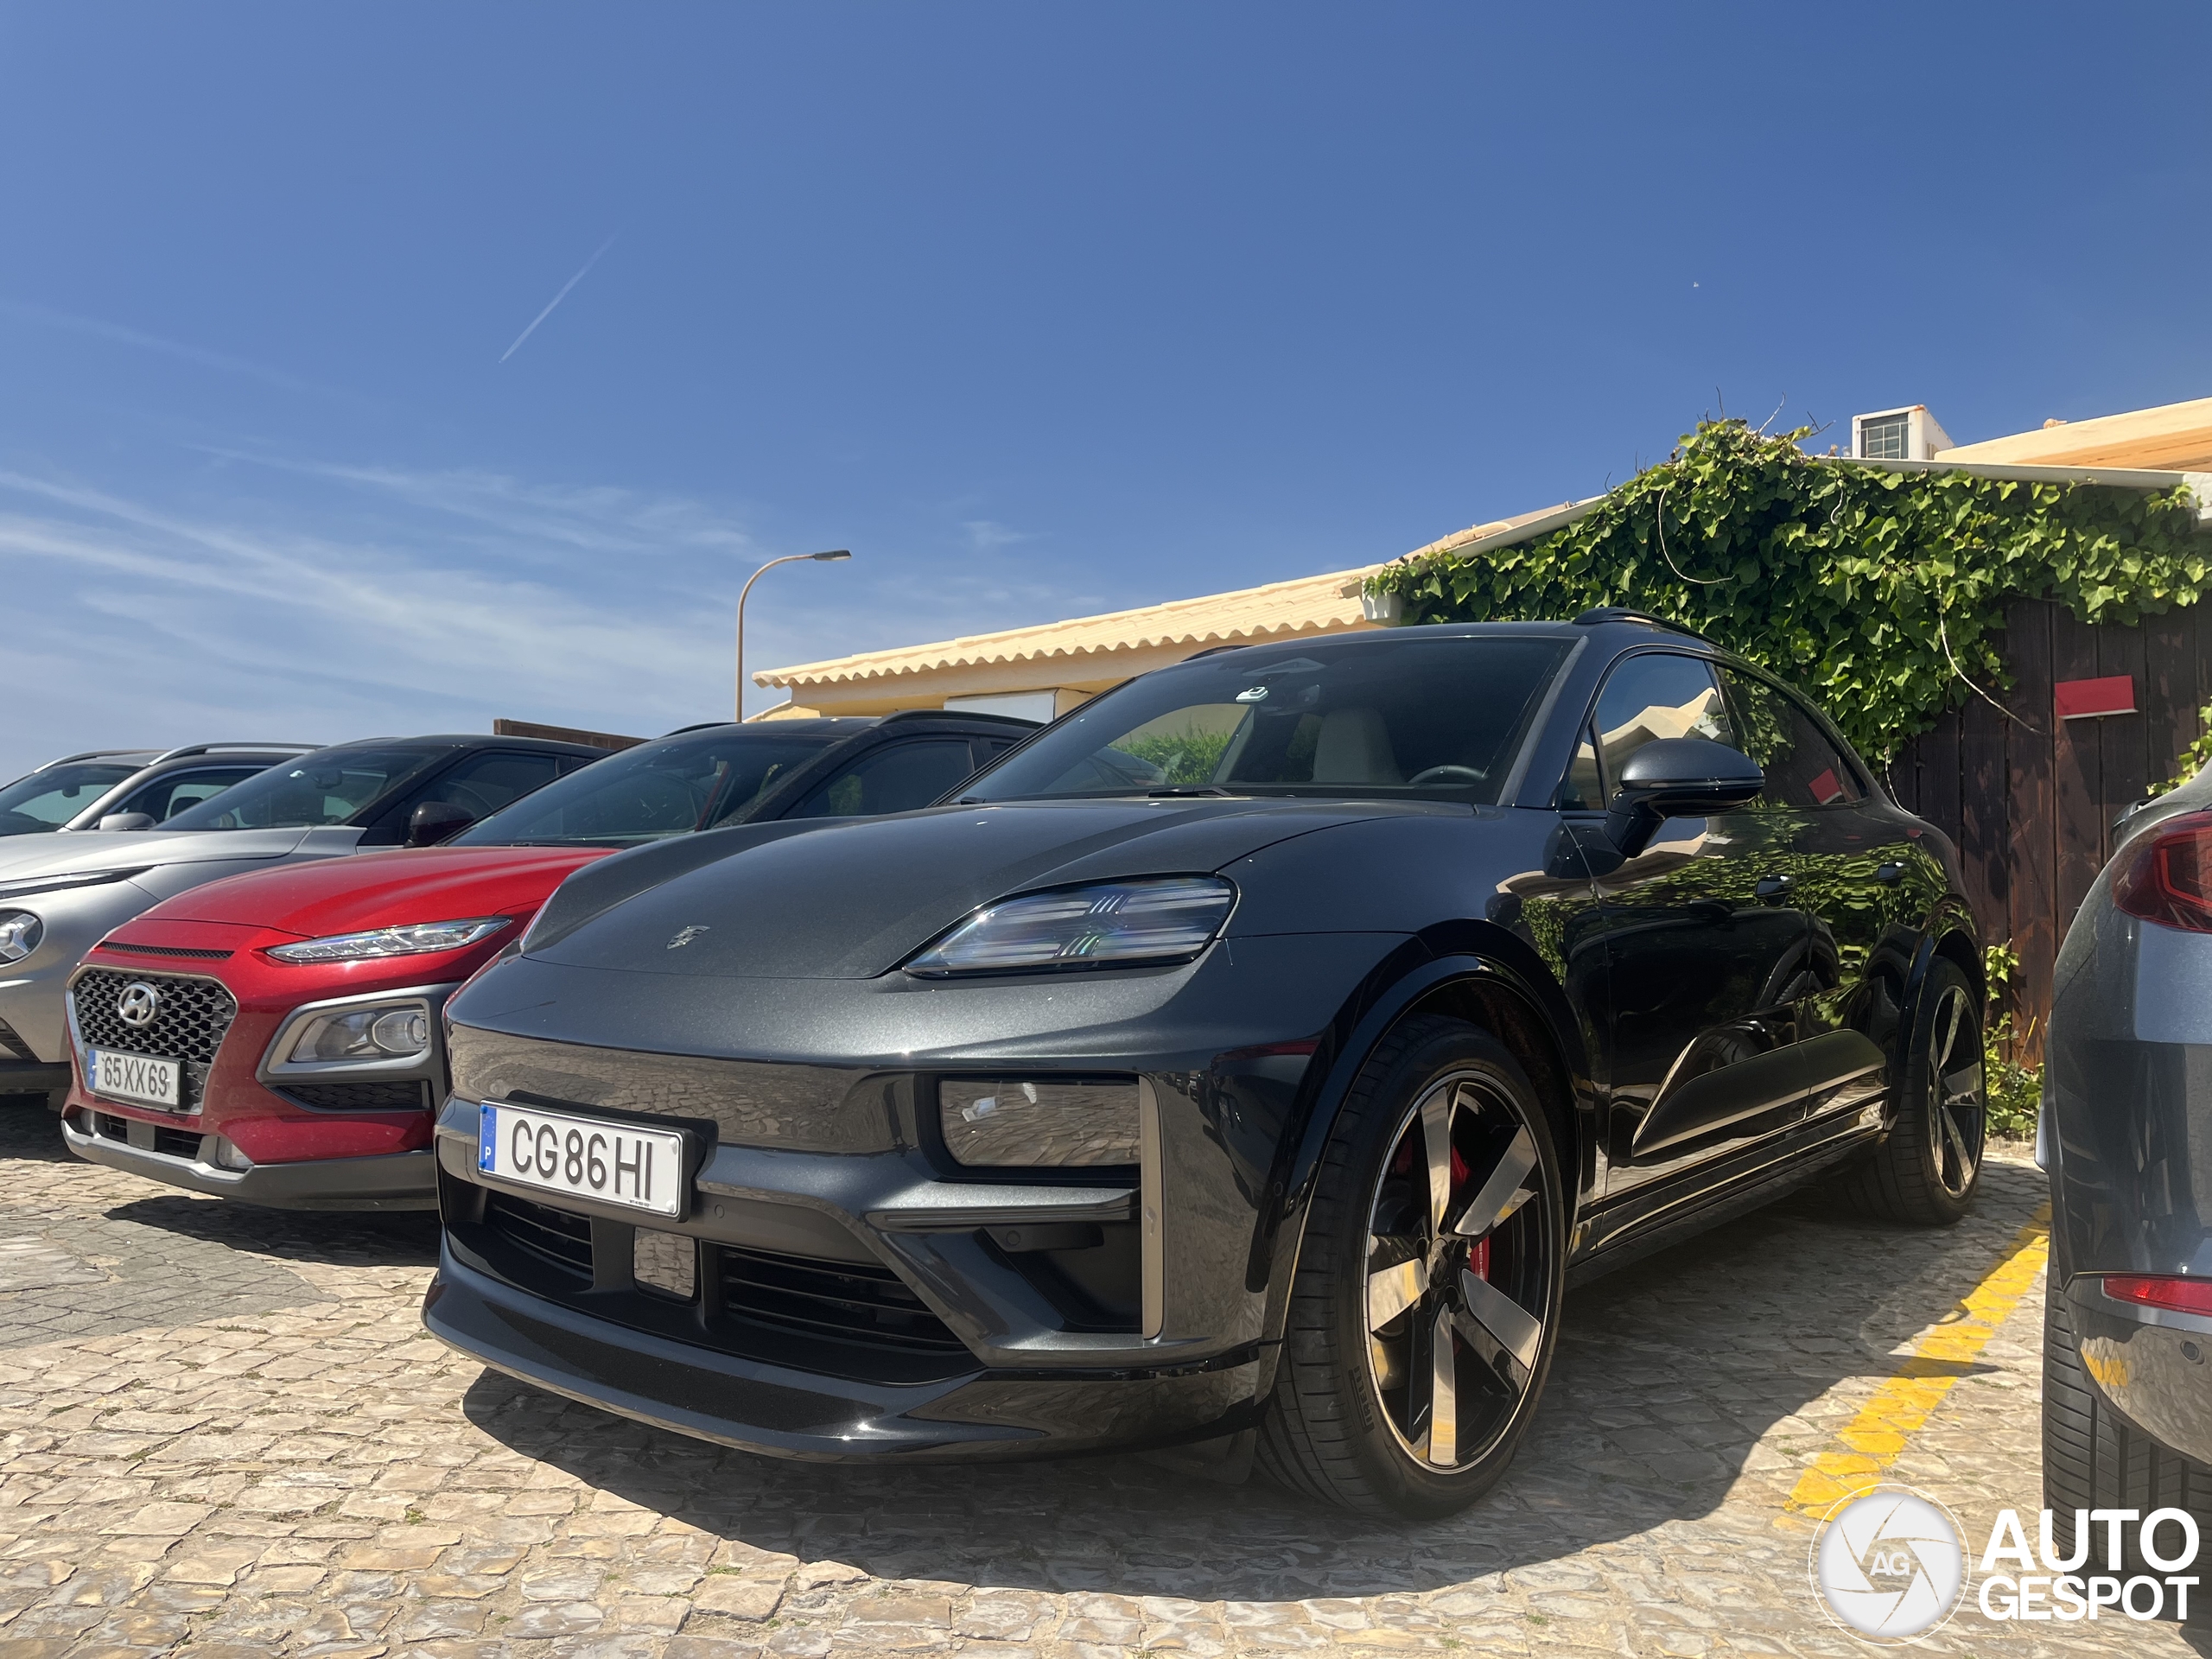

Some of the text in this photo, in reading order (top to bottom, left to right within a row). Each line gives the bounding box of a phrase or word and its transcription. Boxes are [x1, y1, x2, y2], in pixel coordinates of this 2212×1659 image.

[105, 1056, 168, 1097] 65XX69
[485, 1146, 492, 1160] P
[512, 1118, 652, 1201] CG86HI
[1348, 1365, 1375, 1433] PIRELLI
